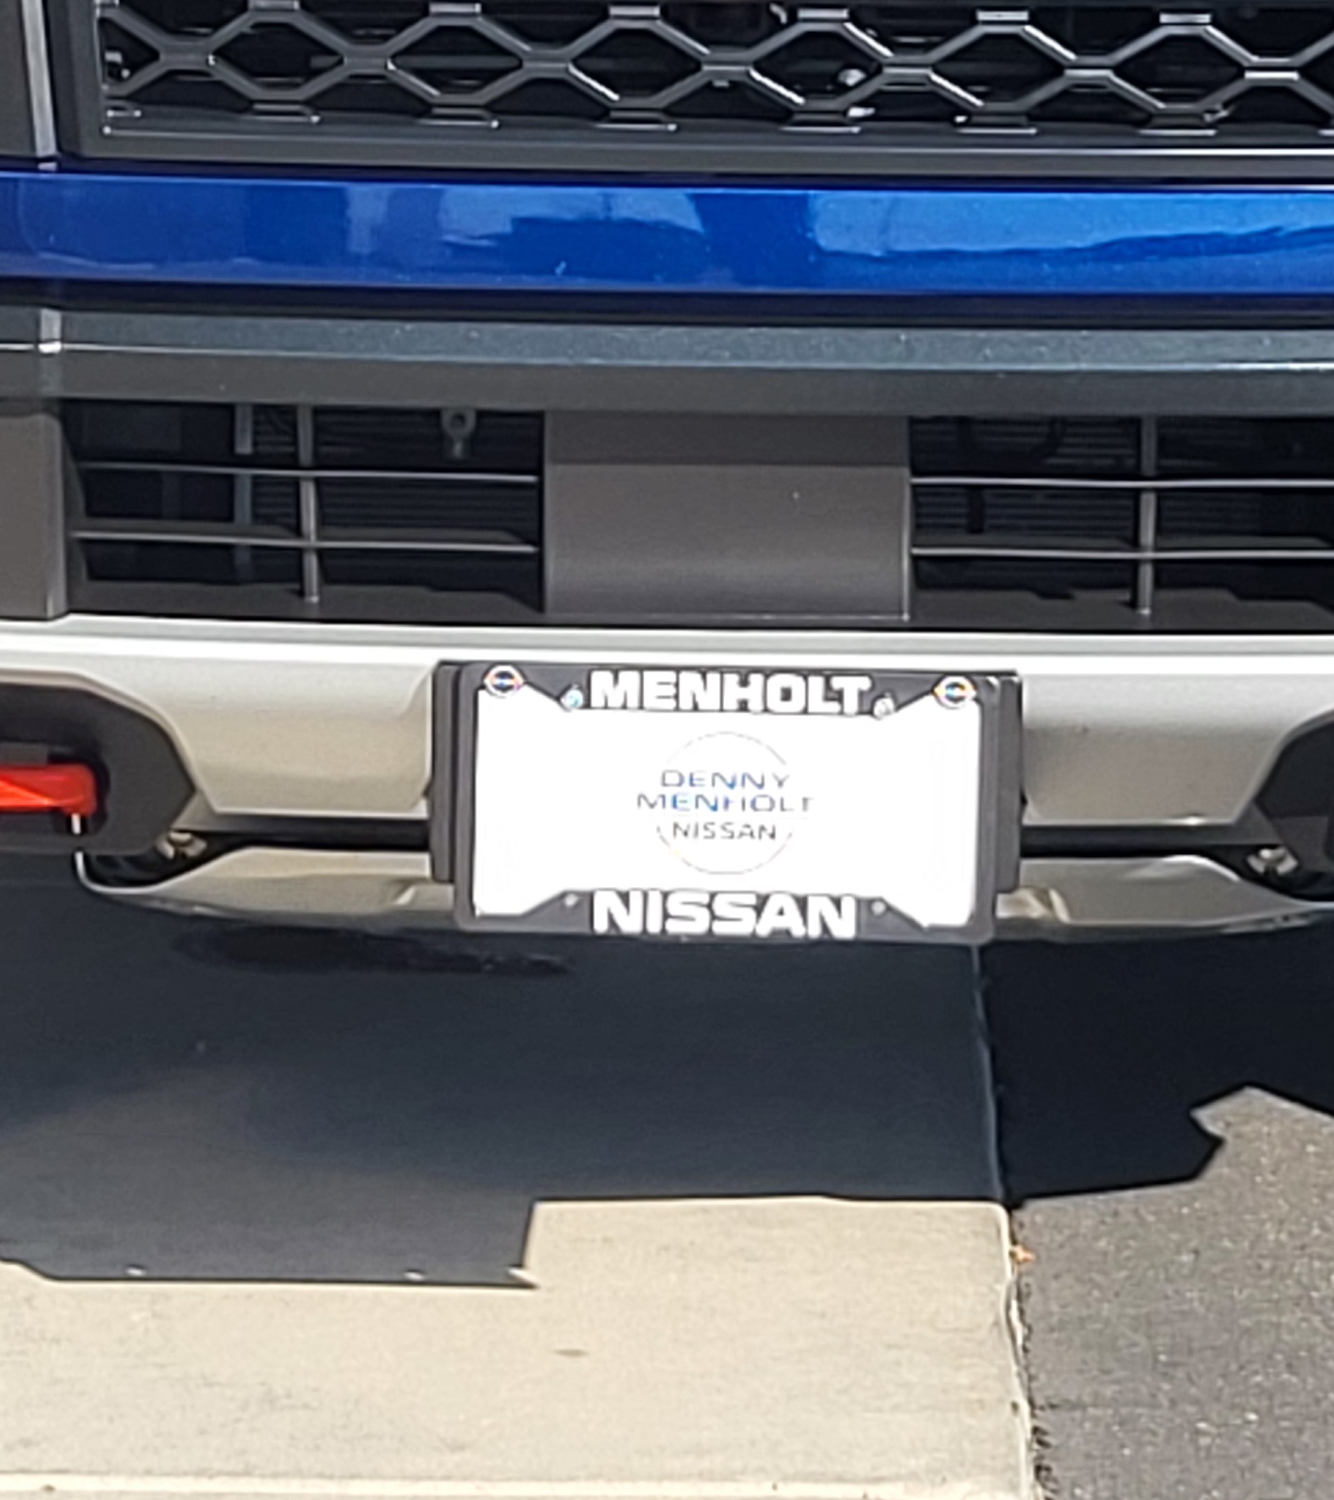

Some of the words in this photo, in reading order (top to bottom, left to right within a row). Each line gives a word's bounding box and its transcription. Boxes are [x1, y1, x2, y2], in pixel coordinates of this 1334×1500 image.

[590, 669, 871, 715] MENHOLT
[660, 769, 790, 790] DENNY
[637, 792, 815, 812] MENHOLT
[673, 821, 776, 840] NISSAN
[592, 889, 857, 939] NISSAN
